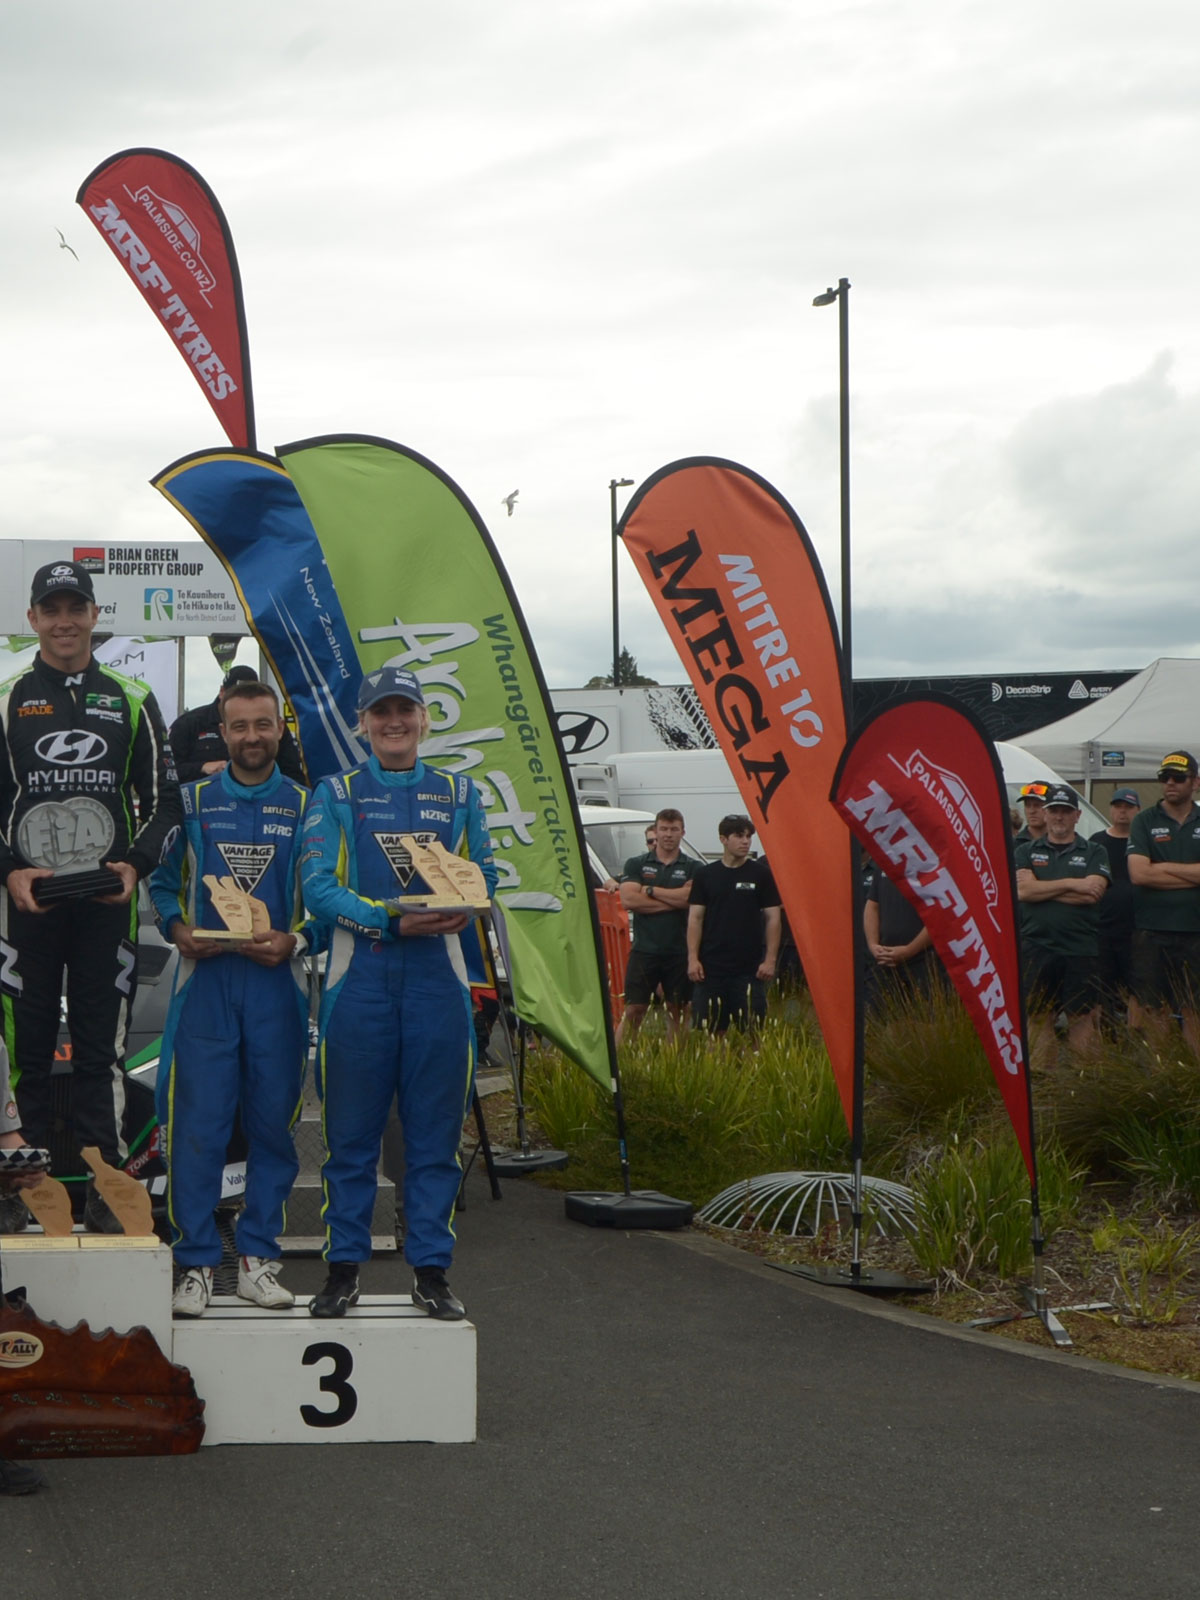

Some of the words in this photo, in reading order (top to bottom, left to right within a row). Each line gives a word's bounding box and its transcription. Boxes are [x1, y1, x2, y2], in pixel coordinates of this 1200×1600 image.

[138, 193, 211, 289] PALMSIDE.CO.NZ
[89, 198, 172, 294] MRF
[160, 294, 238, 400] TYRES
[109, 548, 142, 561] BRIAN
[144, 548, 179, 561] GREEN
[109, 563, 164, 576] PROPERTY
[166, 563, 204, 576] GROUP
[177, 589, 186, 599] Te
[300, 566, 322, 608] New
[318, 612, 351, 680] Zealand
[717, 554, 801, 689] MITRE
[780, 688, 824, 748] 10
[645, 528, 791, 825] MEGA
[1006, 685, 1051, 695] DecraStrip
[17, 705, 54, 718] TRADE
[28, 769, 115, 786] HYUNDAI
[420, 810, 450, 823] NZRC
[263, 824, 293, 837] NZRC
[911, 761, 997, 903] PALMSIDE.CO.NZ
[223, 846, 272, 856] VANTAGE
[844, 779, 969, 918] MRF
[947, 916, 1023, 1076] TYRES
[128, 1151, 150, 1172] TOW
[300, 1342, 357, 1427] 3
